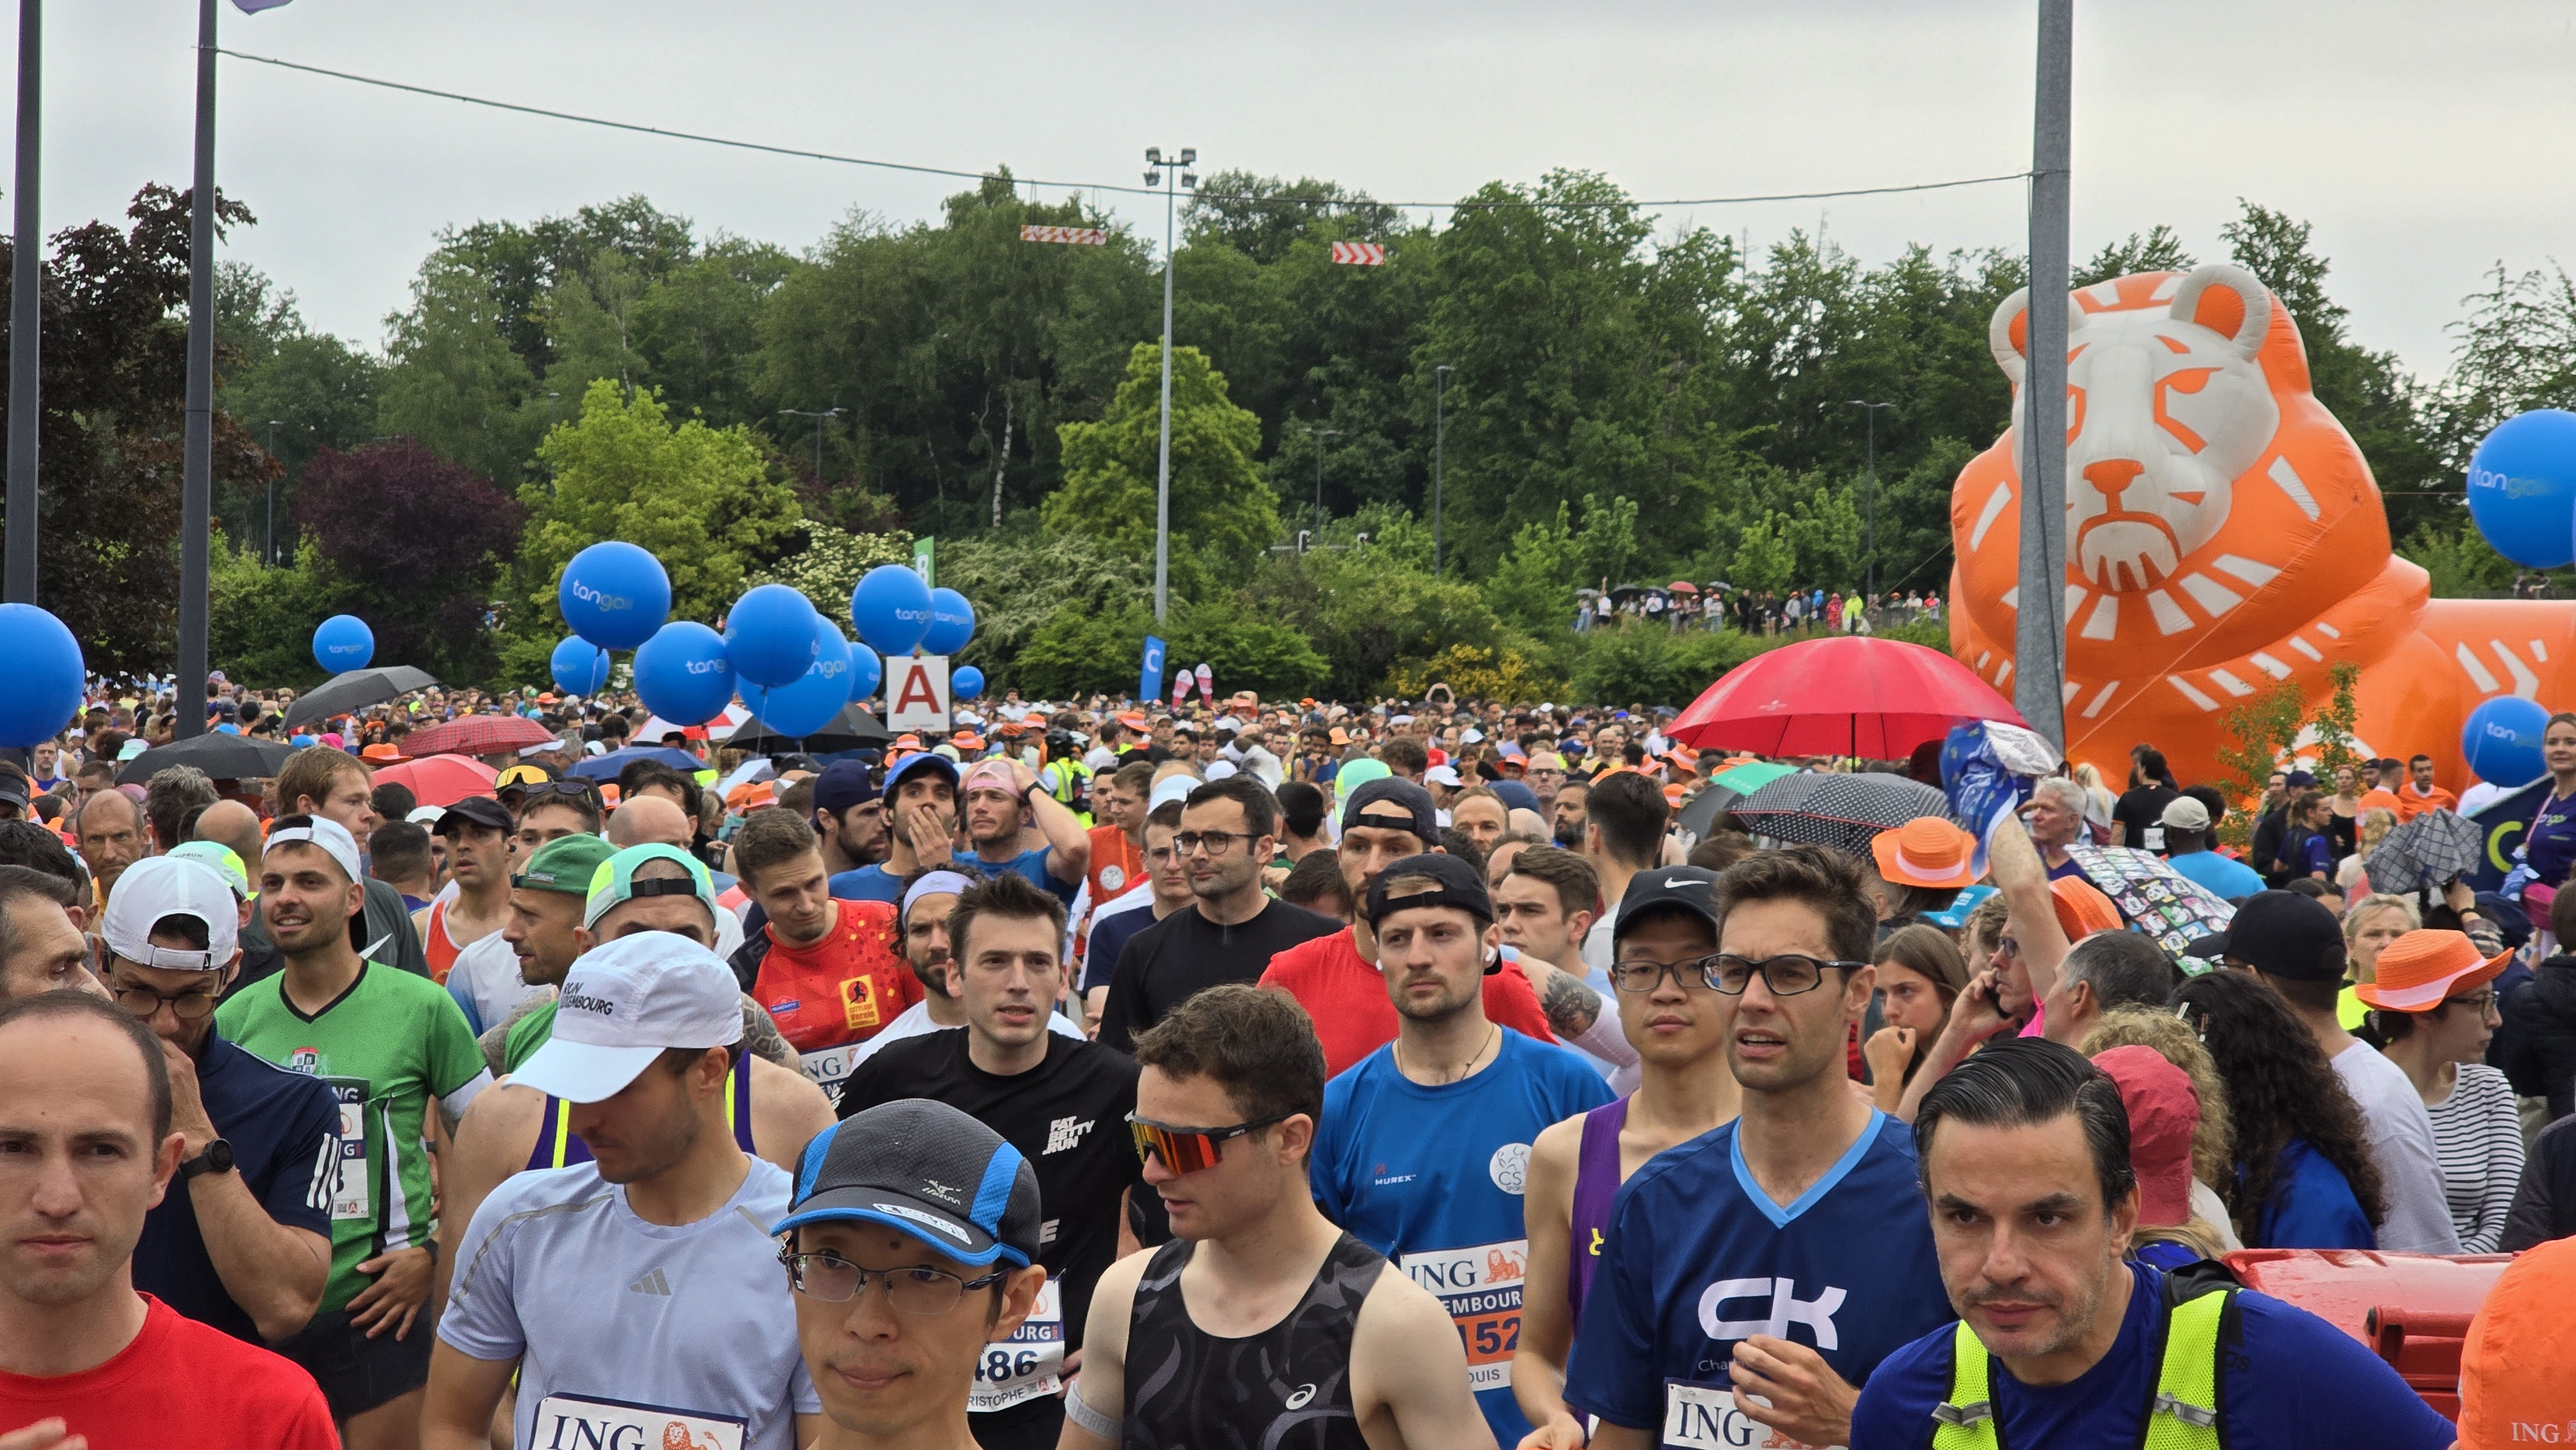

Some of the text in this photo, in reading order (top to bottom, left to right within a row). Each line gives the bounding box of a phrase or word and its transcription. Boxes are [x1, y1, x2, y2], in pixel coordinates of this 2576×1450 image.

[1146, 648, 1160, 672] C
[894, 664, 942, 714] A
[808, 1057, 842, 1079] NG
[1048, 1120, 1095, 1144] BETTY
[1050, 1115, 1077, 1133] FAT
[1042, 1135, 1079, 1156] RUN
[1410, 1259, 1478, 1290] ING
[968, 1387, 1027, 1407] RISTOPHE
[547, 1414, 646, 1450] ING
[1676, 1400, 1754, 1447] ING
[2512, 1421, 2560, 1444] ING
